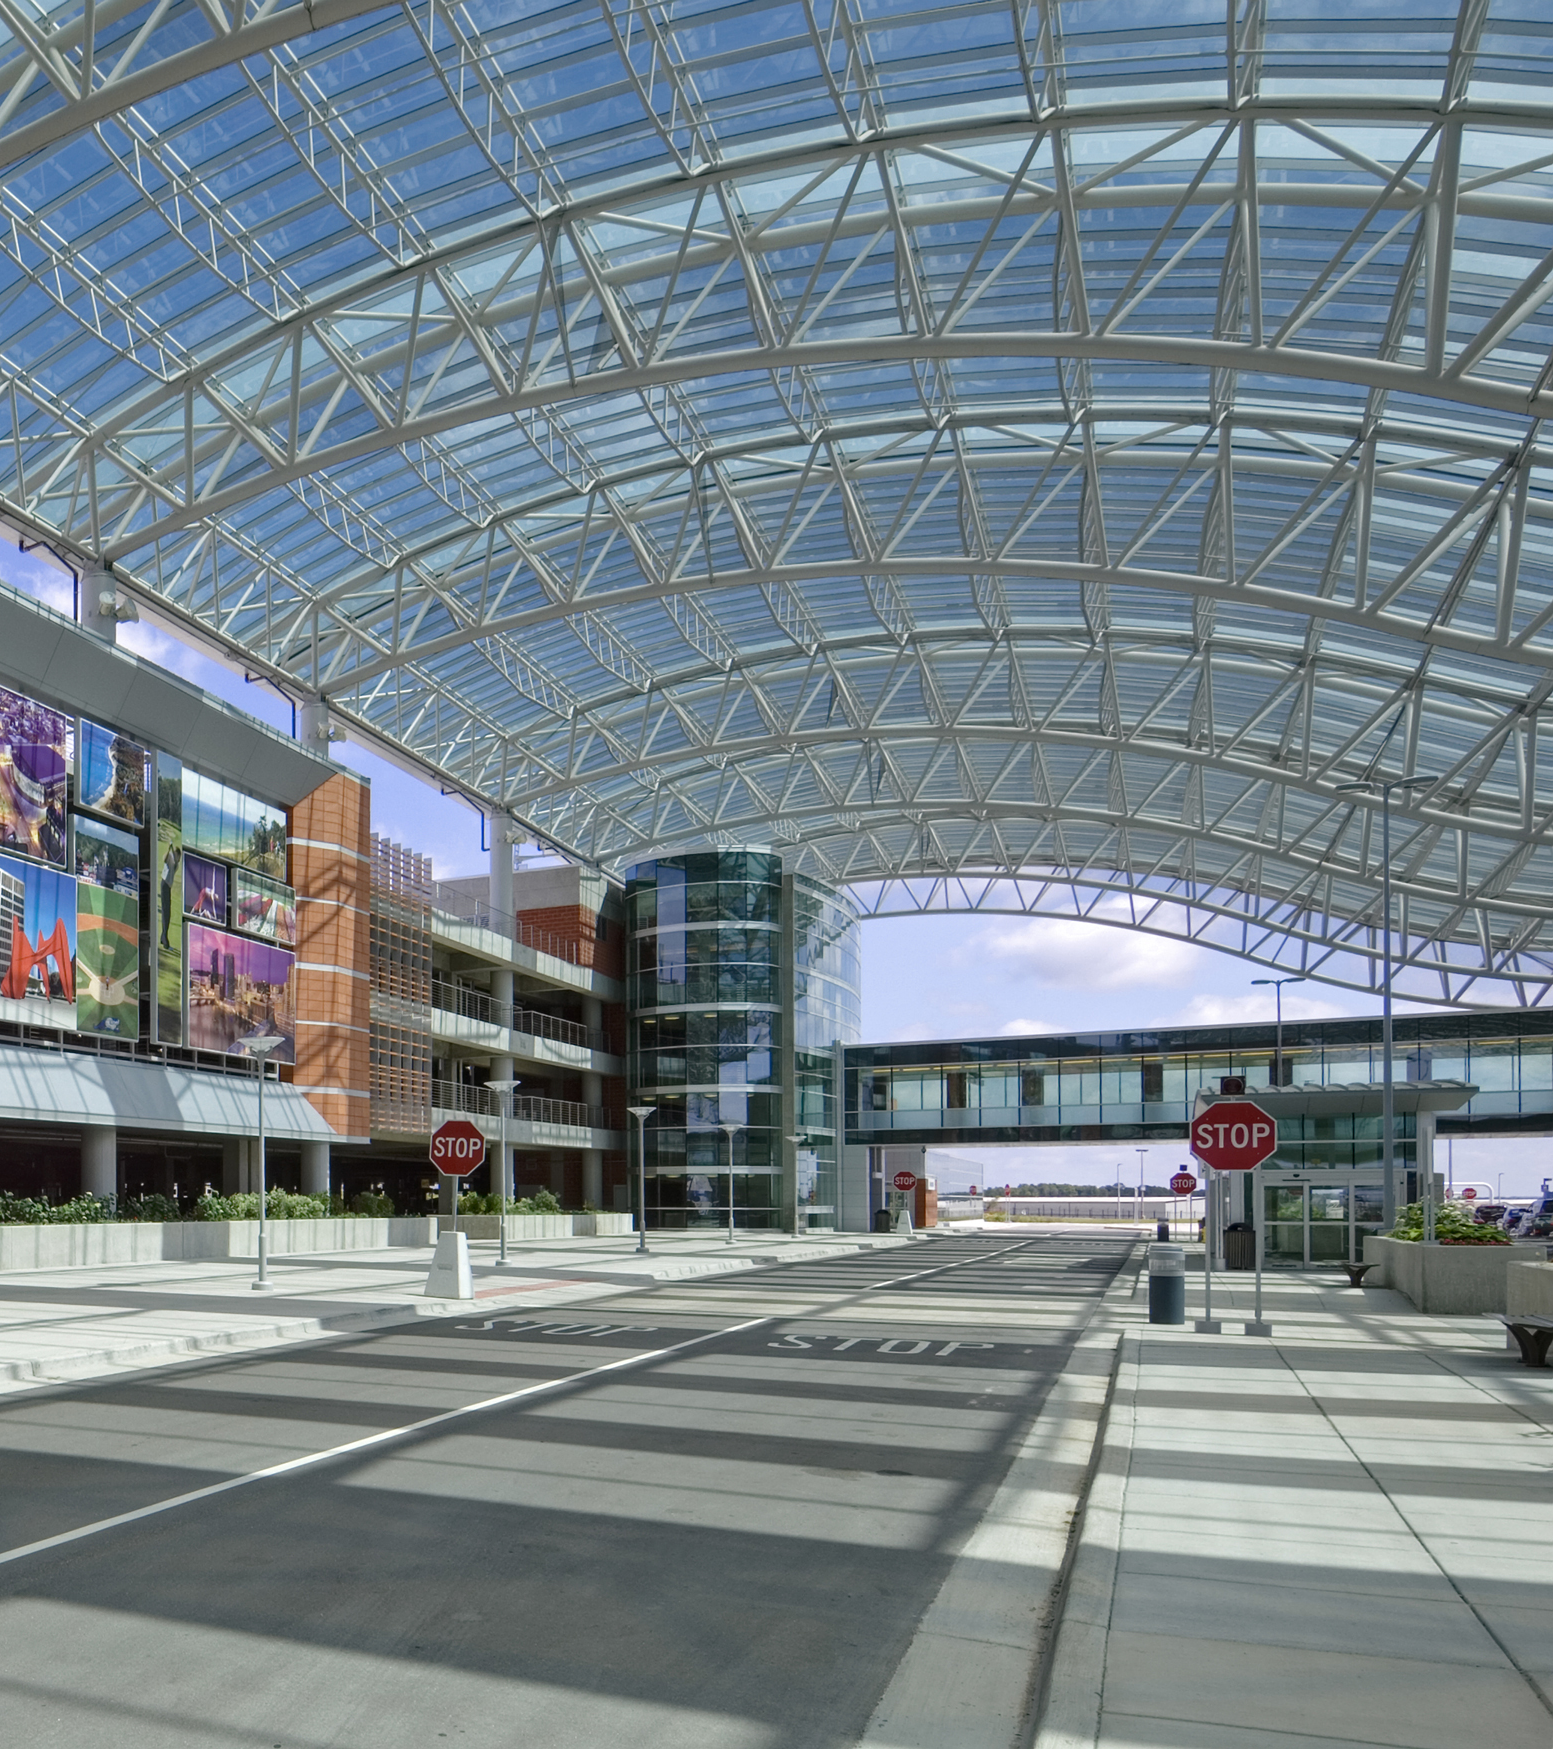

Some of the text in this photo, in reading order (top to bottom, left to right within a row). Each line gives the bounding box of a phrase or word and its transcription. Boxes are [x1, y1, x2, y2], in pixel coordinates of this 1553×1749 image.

[1196, 1123, 1270, 1149] STOP
[434, 1137, 482, 1158] STOP
[894, 1176, 915, 1185] STOP
[1171, 1179, 1195, 1188] STOP
[454, 1319, 658, 1337] STOP
[767, 1334, 995, 1357] STOP
